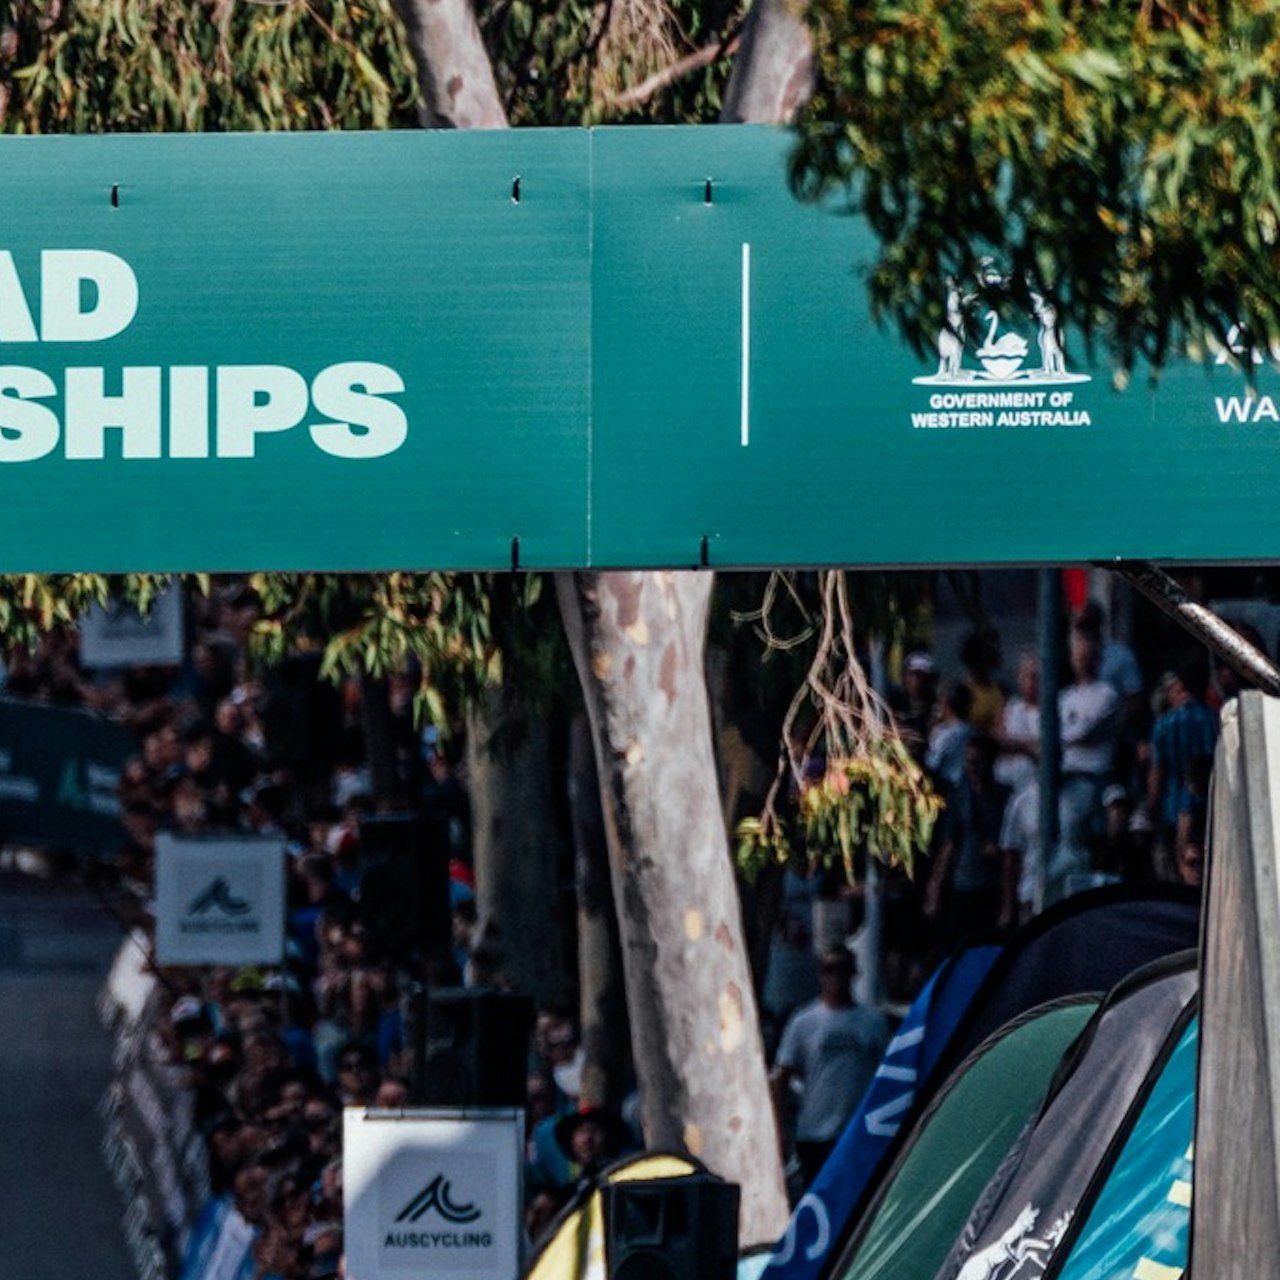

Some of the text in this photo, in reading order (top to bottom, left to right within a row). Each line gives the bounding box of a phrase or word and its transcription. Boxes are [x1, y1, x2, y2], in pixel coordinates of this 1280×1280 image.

[929, 391, 1074, 409] GOVERNMENT OF
[911, 410, 1092, 428] WESTERN AUSTRALIA
[384, 1233, 492, 1248] AUSCYCLING
